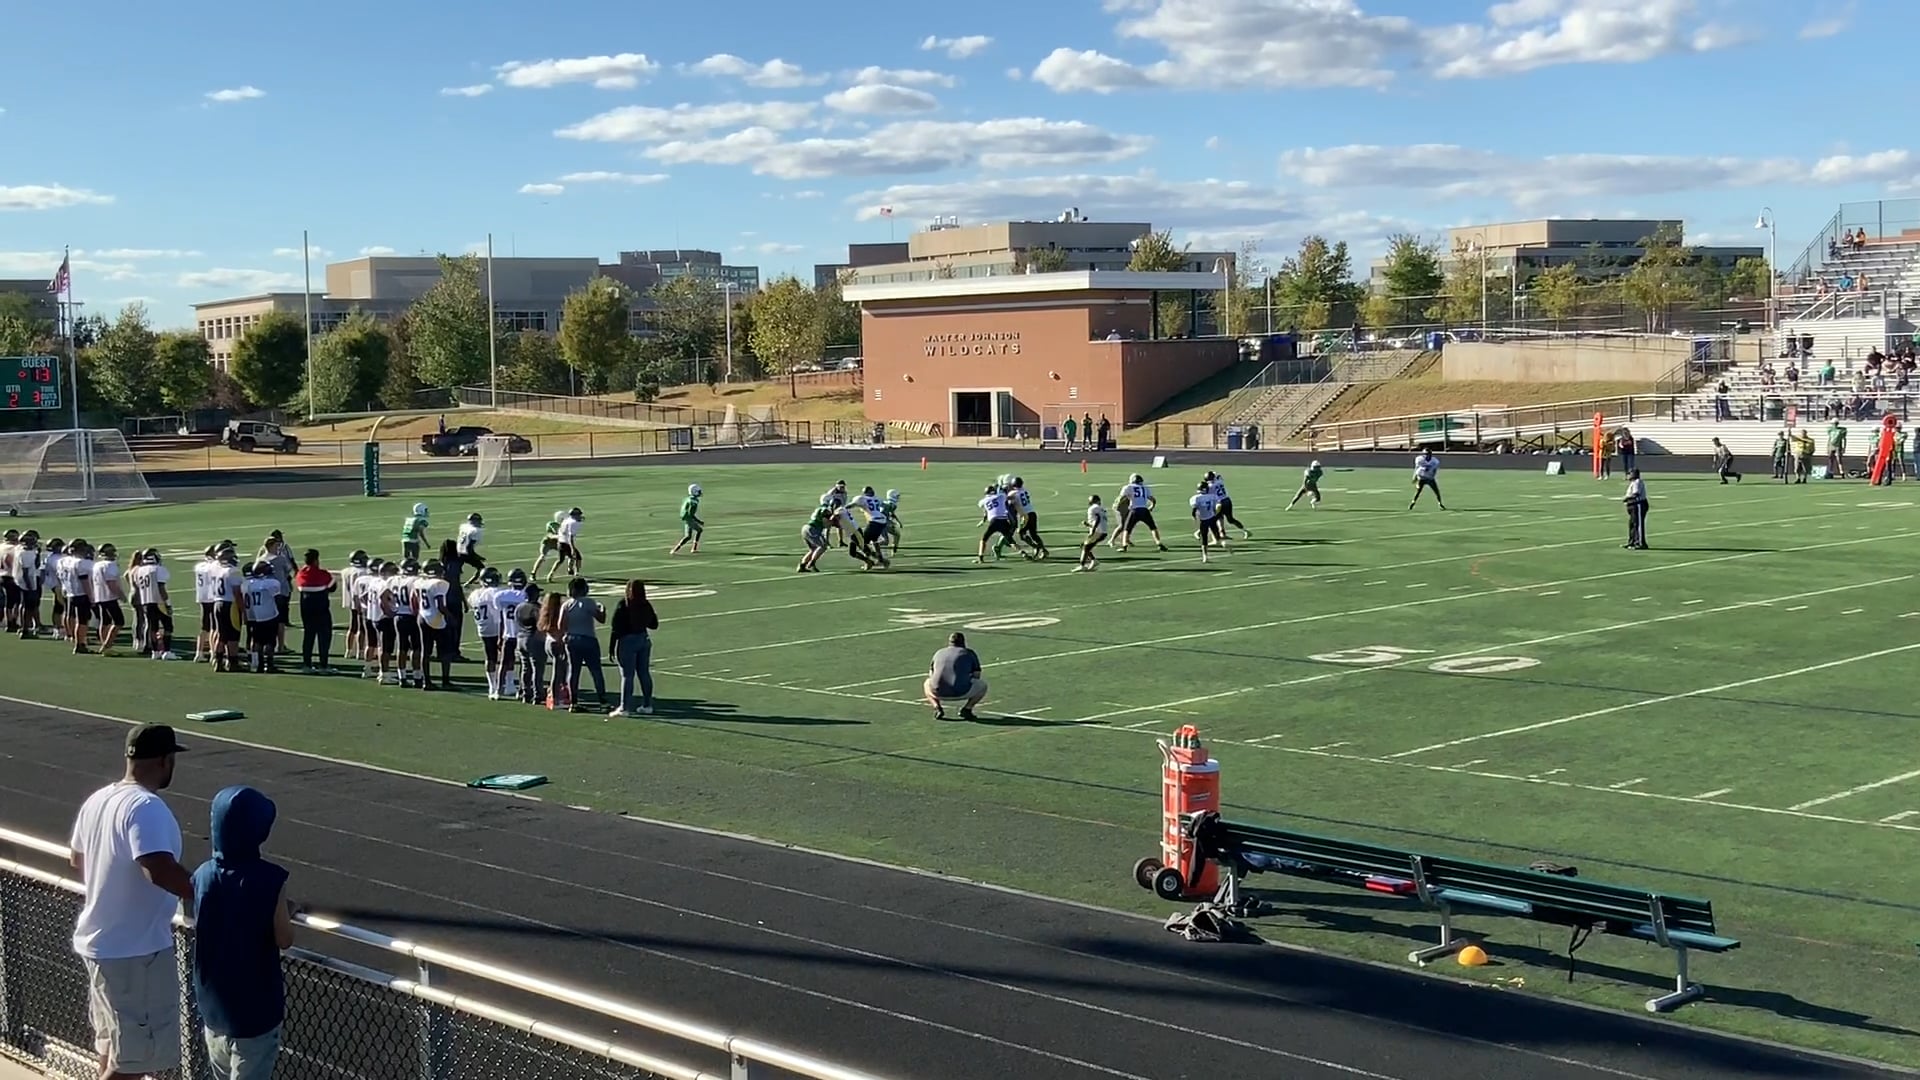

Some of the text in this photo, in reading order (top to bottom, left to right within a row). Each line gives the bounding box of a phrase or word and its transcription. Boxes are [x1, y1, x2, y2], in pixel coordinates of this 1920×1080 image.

[923, 331, 1020, 343] WALTER JOHNSON
[924, 342, 1021, 357] WILDCATS
[21, 358, 51, 368] GUEST
[35, 367, 50, 382] 13
[5, 384, 21, 393] QTR
[9, 393, 18, 407] 2
[1133, 486, 1147, 501] 51
[986, 497, 999, 511] 55
[252, 591, 261, 606] 17
[1307, 644, 1543, 674] 50
